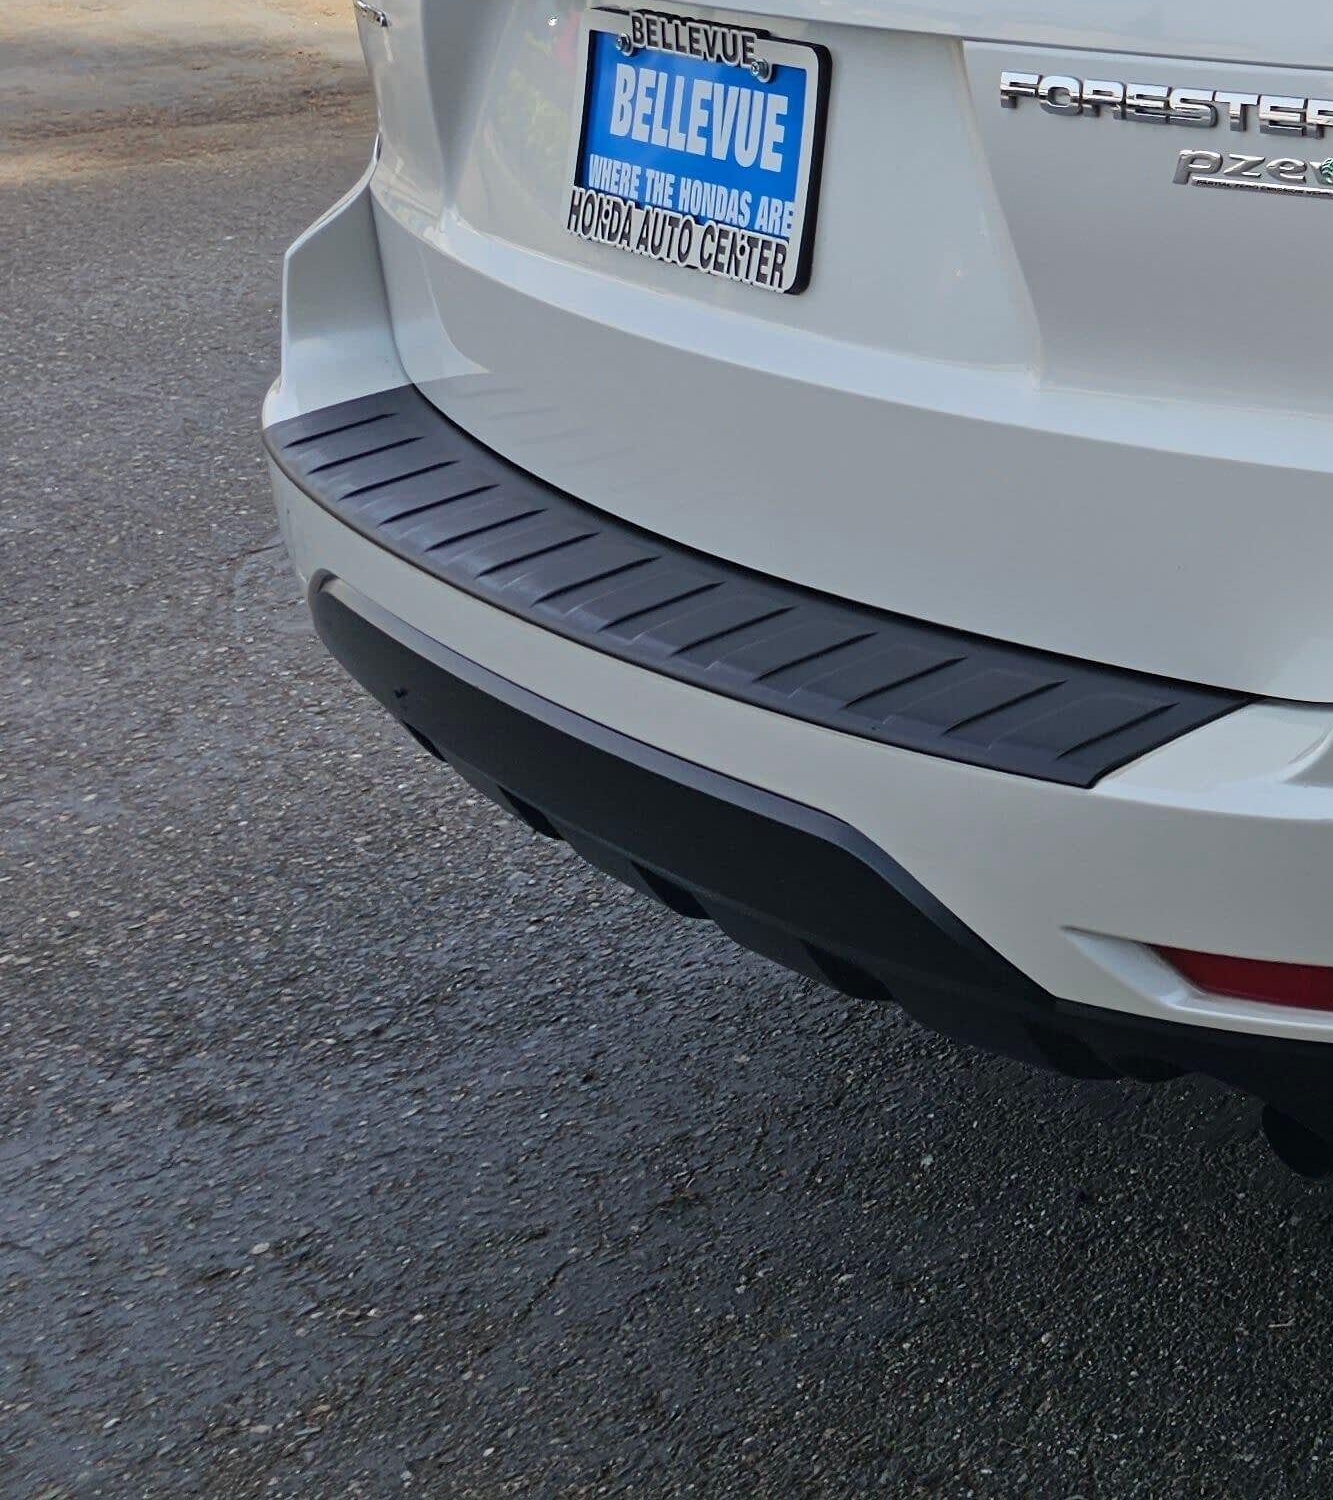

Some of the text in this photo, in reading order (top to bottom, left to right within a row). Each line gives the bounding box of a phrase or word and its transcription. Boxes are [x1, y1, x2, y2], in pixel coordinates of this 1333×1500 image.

[632, 12, 757, 67] BELLEVUE
[609, 62, 788, 173] BELLEVUE
[567, 189, 790, 290] HONDA AUTO CENTER
[588, 153, 794, 238] WHERE THE HONDAS ARE
